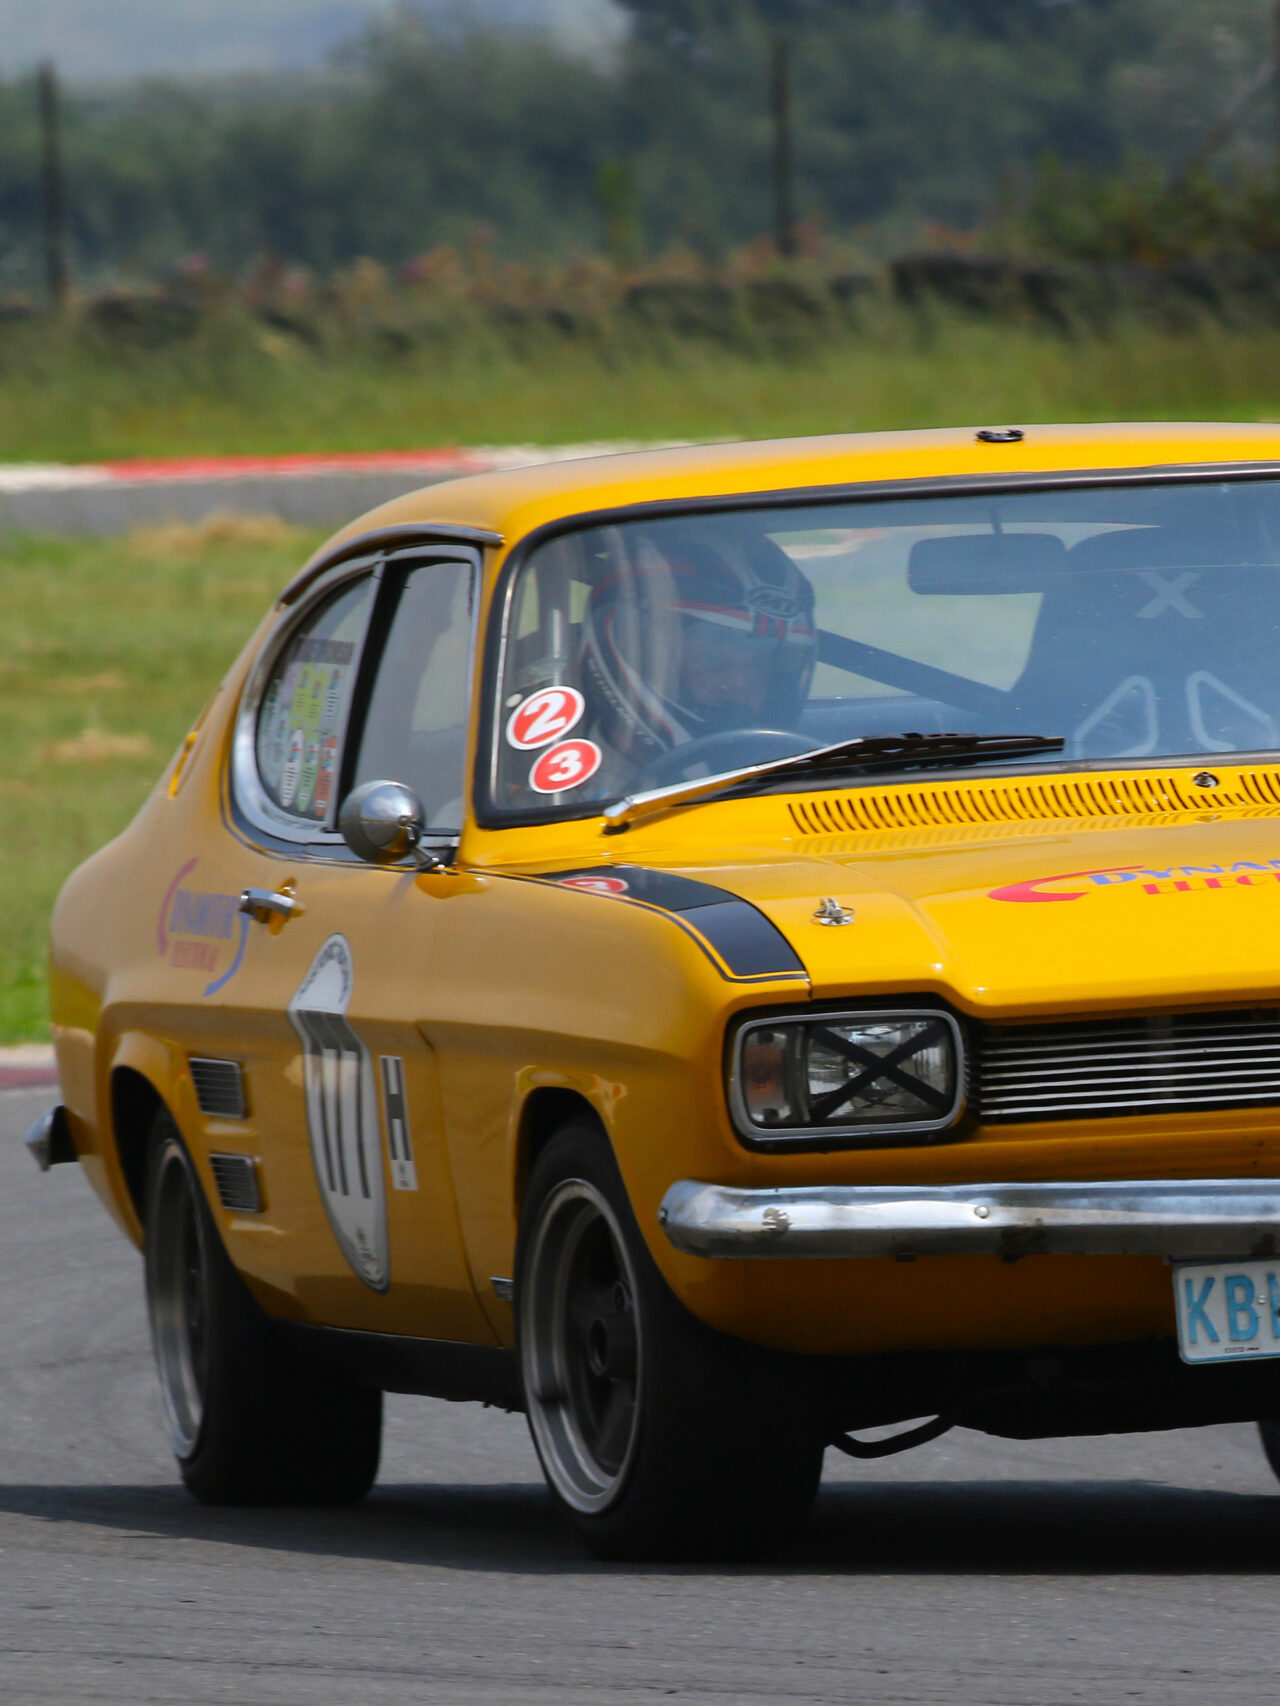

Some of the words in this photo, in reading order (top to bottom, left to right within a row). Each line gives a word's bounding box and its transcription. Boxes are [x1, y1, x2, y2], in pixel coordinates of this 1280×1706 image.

[523, 692, 566, 742] 2
[548, 749, 583, 782] 3
[380, 1057, 413, 1162] H
